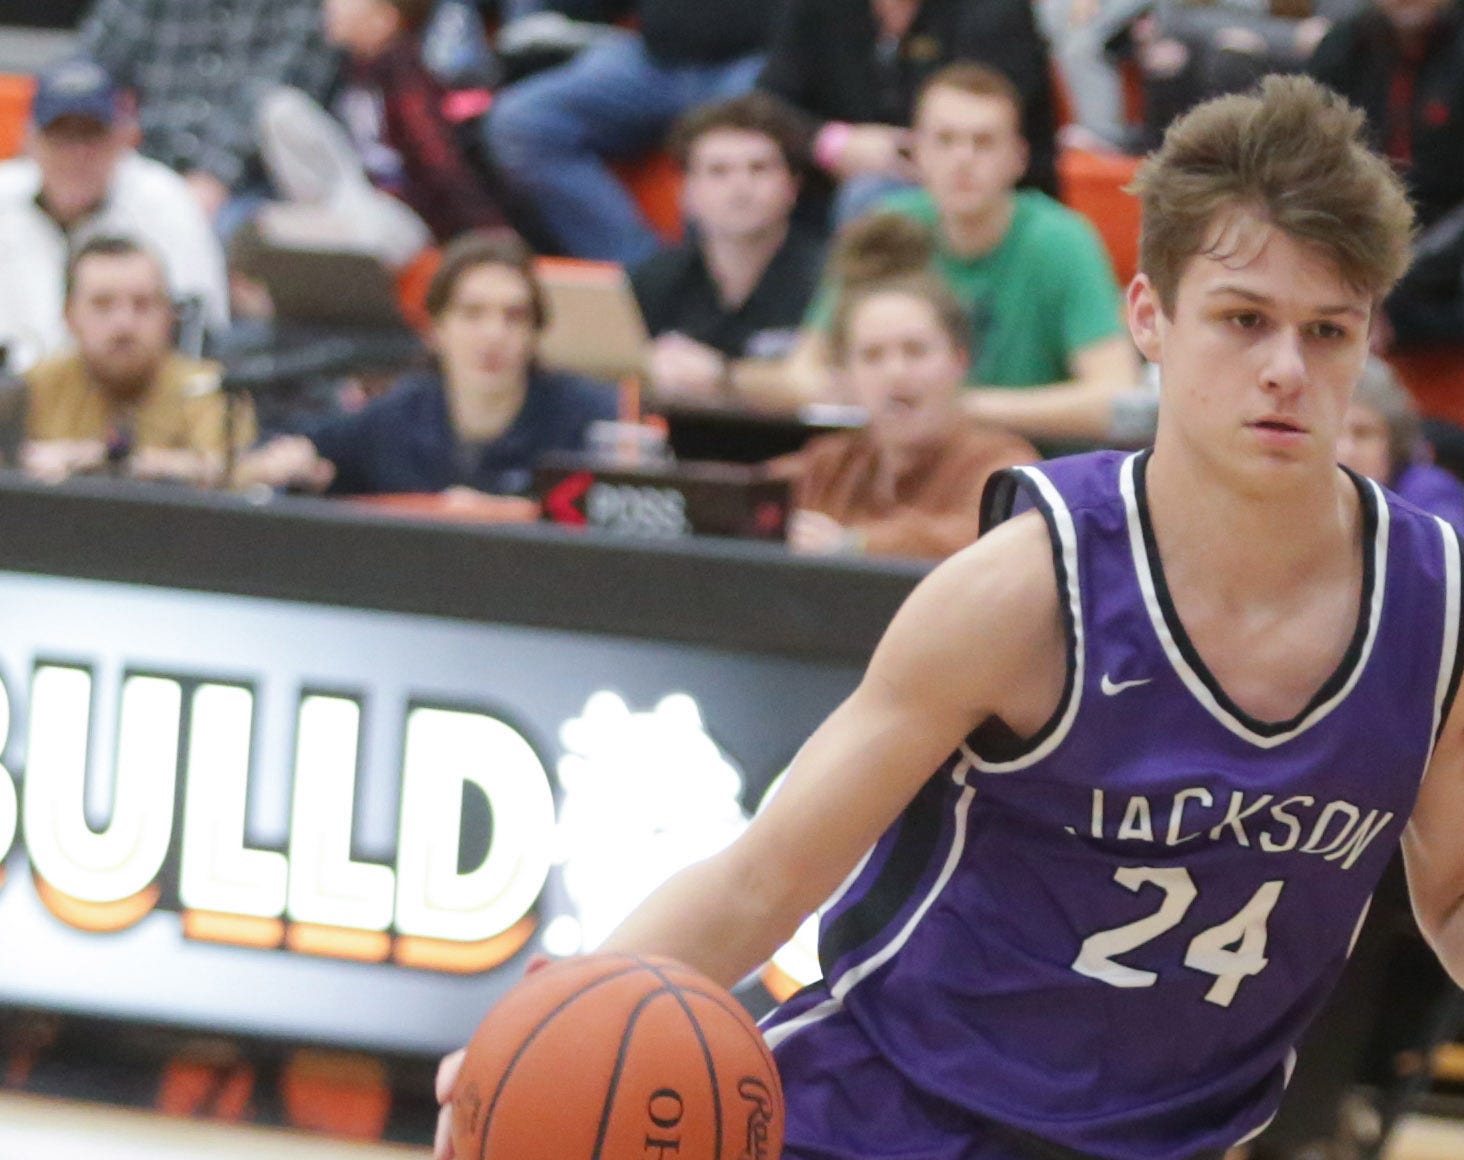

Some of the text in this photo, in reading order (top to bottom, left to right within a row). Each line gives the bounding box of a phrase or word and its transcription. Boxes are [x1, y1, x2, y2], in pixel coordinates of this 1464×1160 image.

[0, 661, 557, 970] ULLD
[1063, 787, 1394, 870] JACKSON
[1071, 866, 1284, 1008] 24
